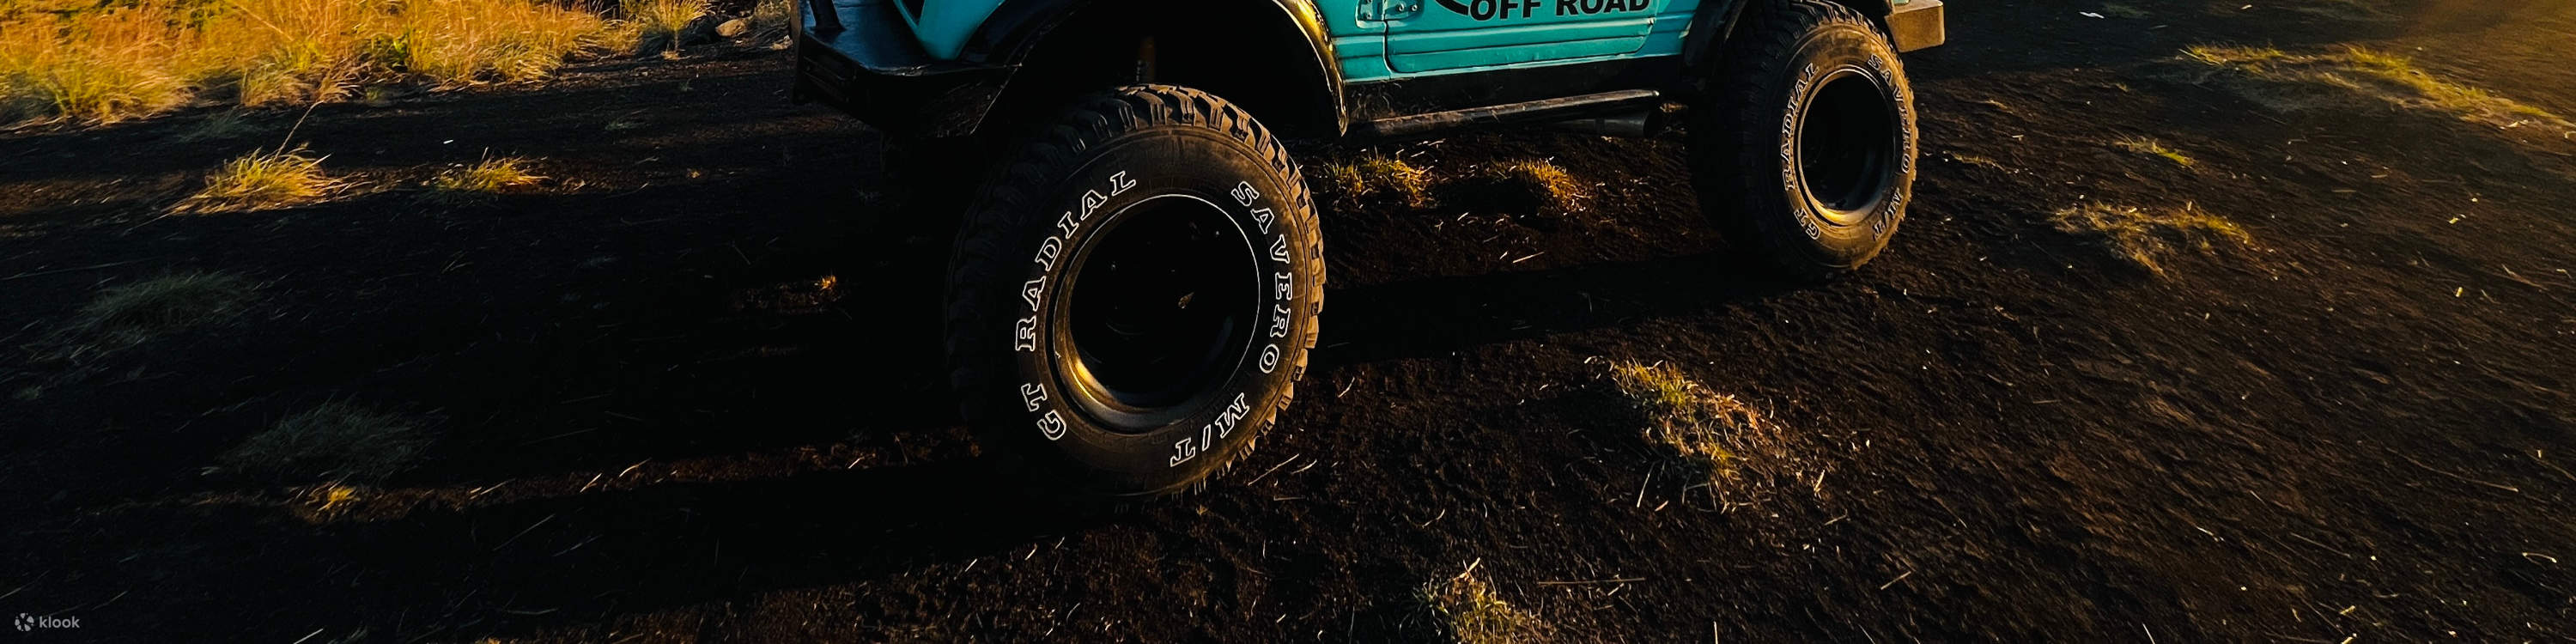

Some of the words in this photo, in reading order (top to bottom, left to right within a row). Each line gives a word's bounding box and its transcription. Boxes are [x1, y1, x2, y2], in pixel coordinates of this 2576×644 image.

[1468, 0, 1542, 21] OFF
[1781, 63, 1819, 191] RADIAL
[1868, 54, 1911, 173] SAVERO
[1794, 210, 1821, 240] GT
[1873, 189, 1903, 241] M/T
[1015, 171, 1136, 351] RADIAL
[1231, 180, 1292, 374] SAVERO
[1021, 383, 1066, 441] GT
[1170, 392, 1249, 467] M/T
